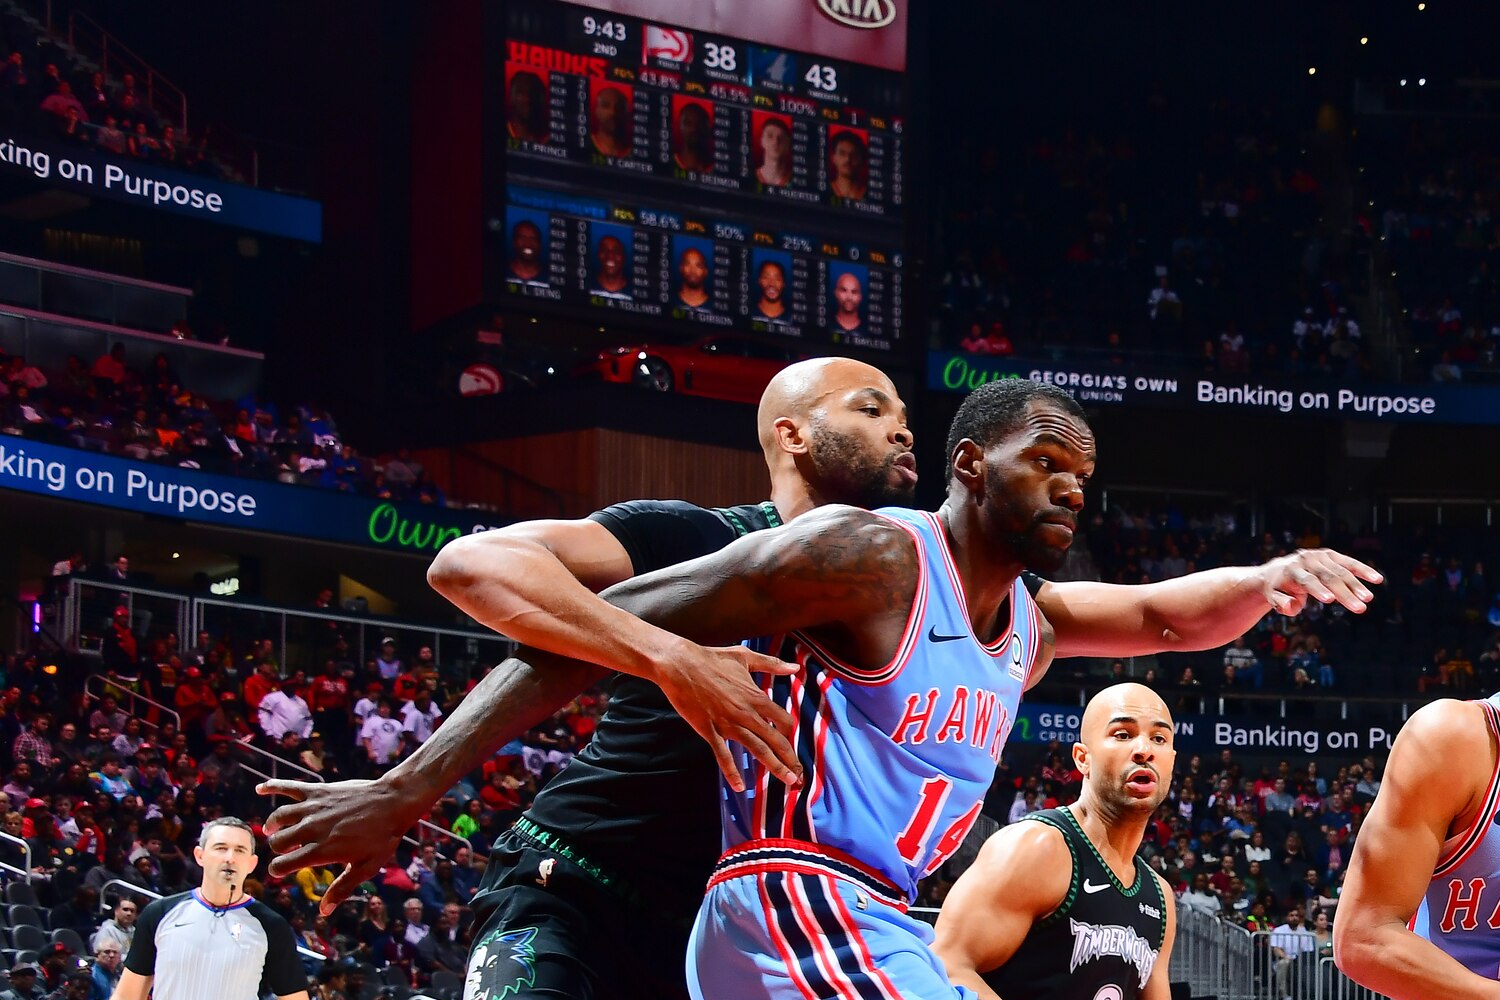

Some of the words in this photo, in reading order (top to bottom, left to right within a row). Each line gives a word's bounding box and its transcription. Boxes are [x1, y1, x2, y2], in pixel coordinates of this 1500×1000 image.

[583, 16, 627, 41] 9:43
[506, 40, 607, 79] HAWKS
[593, 42, 618, 56] 2ND
[703, 42, 737, 71] 38
[804, 64, 837, 91] 43
[779, 97, 817, 117] 100%
[58, 158, 93, 184] on
[104, 163, 223, 212] Purpose
[639, 209, 680, 231] 58.6%
[714, 223, 745, 242] 50%
[782, 235, 812, 253] 25%
[848, 247, 860, 261] 0
[1029, 369, 1127, 390] GEORGIA'S
[1134, 376, 1178, 393] OWN
[1080, 389, 1123, 402] UNION
[1197, 380, 1294, 413] Banking
[1300, 389, 1330, 409] on
[1337, 389, 1436, 417] Purpose
[75, 466, 114, 493] on
[127, 468, 257, 516] Purpose
[1214, 723, 1317, 754] Banking
[1326, 729, 1360, 748] on
[895, 774, 984, 877] 14
